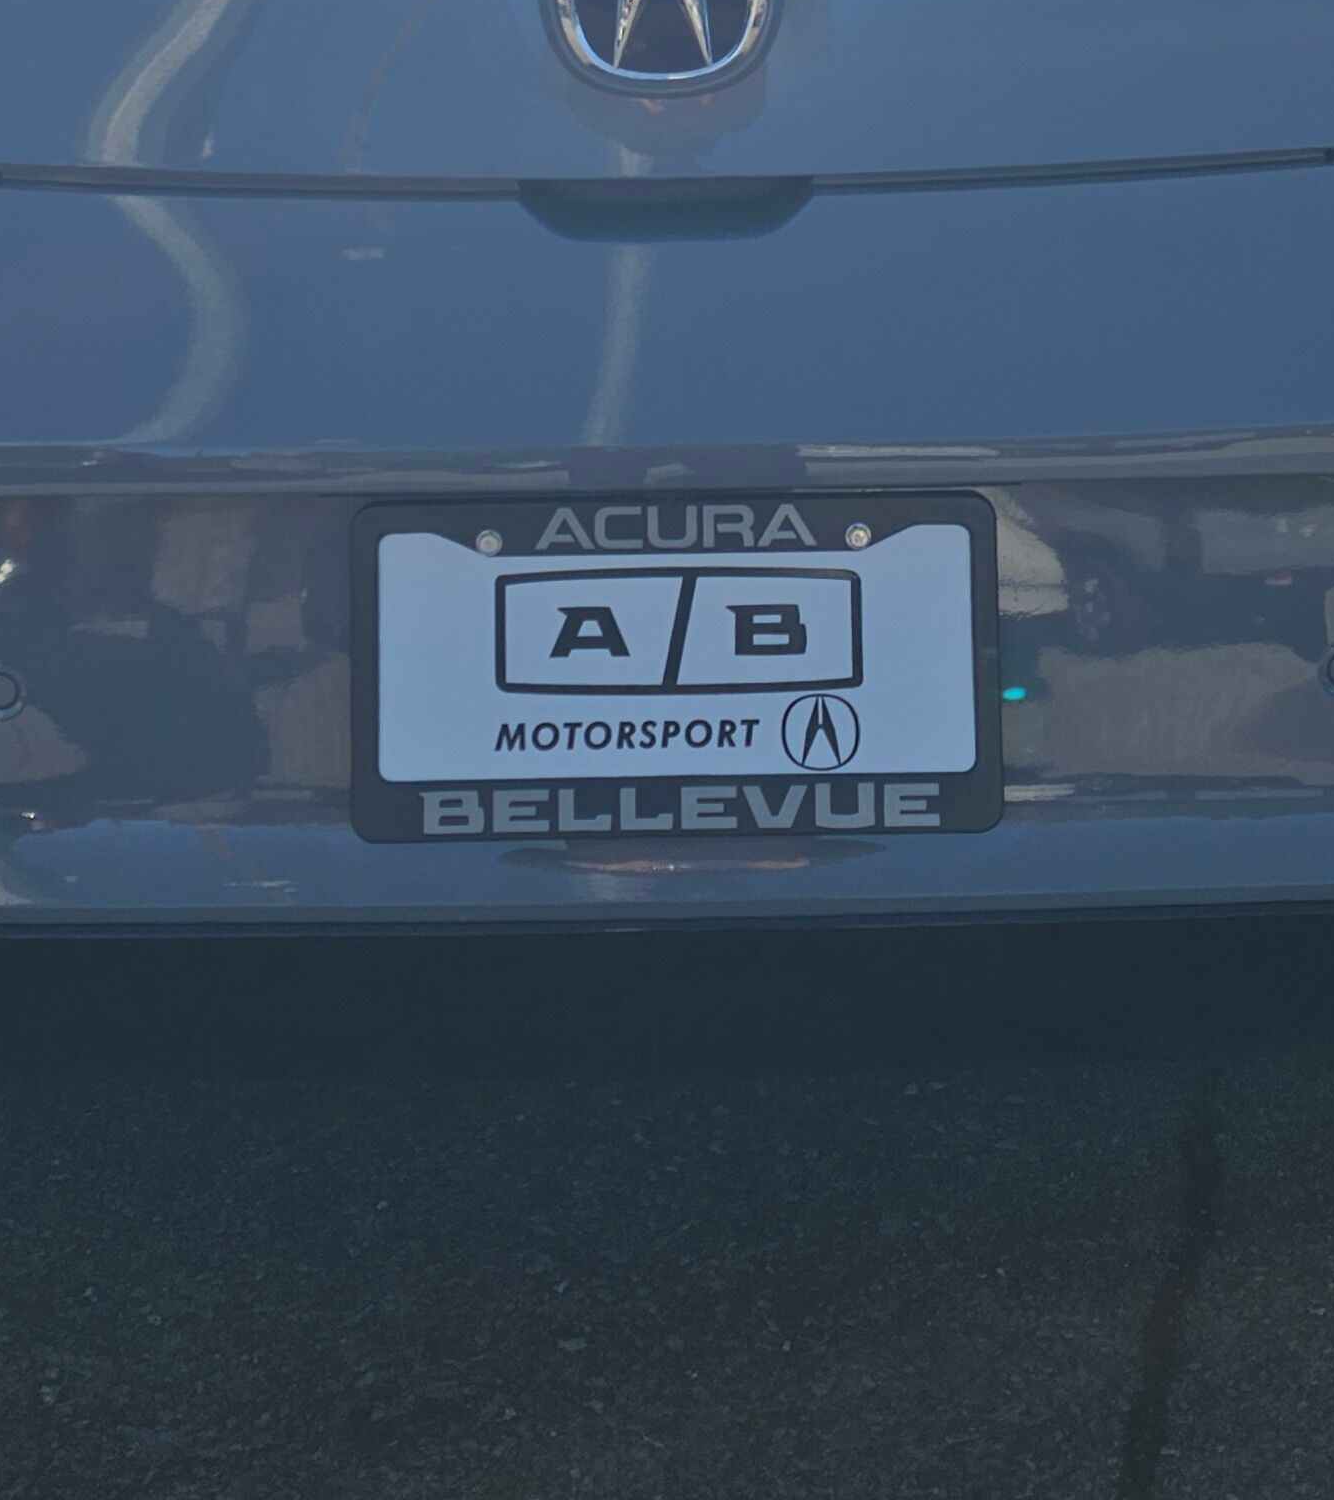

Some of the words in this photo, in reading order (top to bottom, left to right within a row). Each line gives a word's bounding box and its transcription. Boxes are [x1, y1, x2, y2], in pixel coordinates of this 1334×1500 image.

[534, 503, 818, 551] ACURA
[494, 718, 762, 753] MOTORSPORT
[417, 782, 941, 836] BELLEVUE
